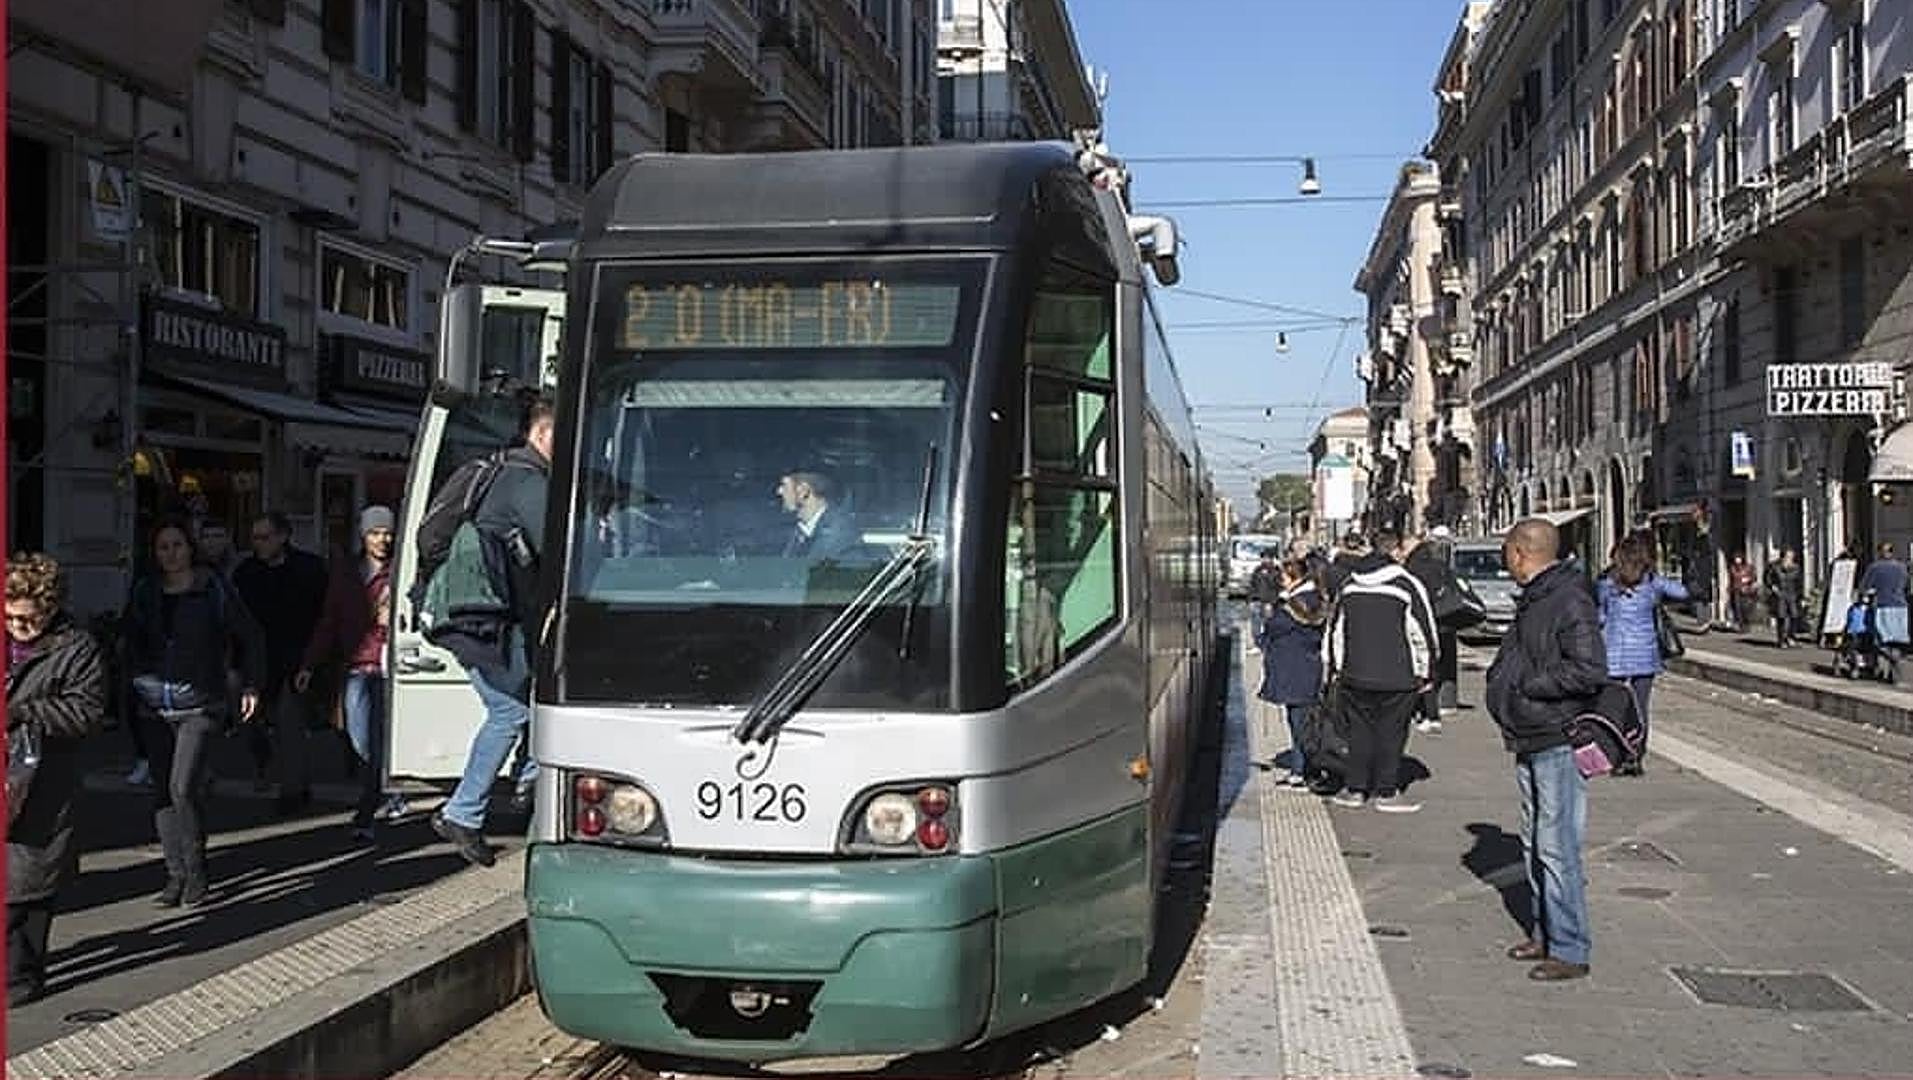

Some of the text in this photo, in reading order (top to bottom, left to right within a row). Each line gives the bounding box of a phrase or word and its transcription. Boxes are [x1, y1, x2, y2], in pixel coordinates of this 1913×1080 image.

[154, 310, 281, 369] RISTORANTE
[624, 283, 648, 347] 2
[1776, 391, 1885, 413] PIZZERIA
[697, 781, 807, 823] 9126
